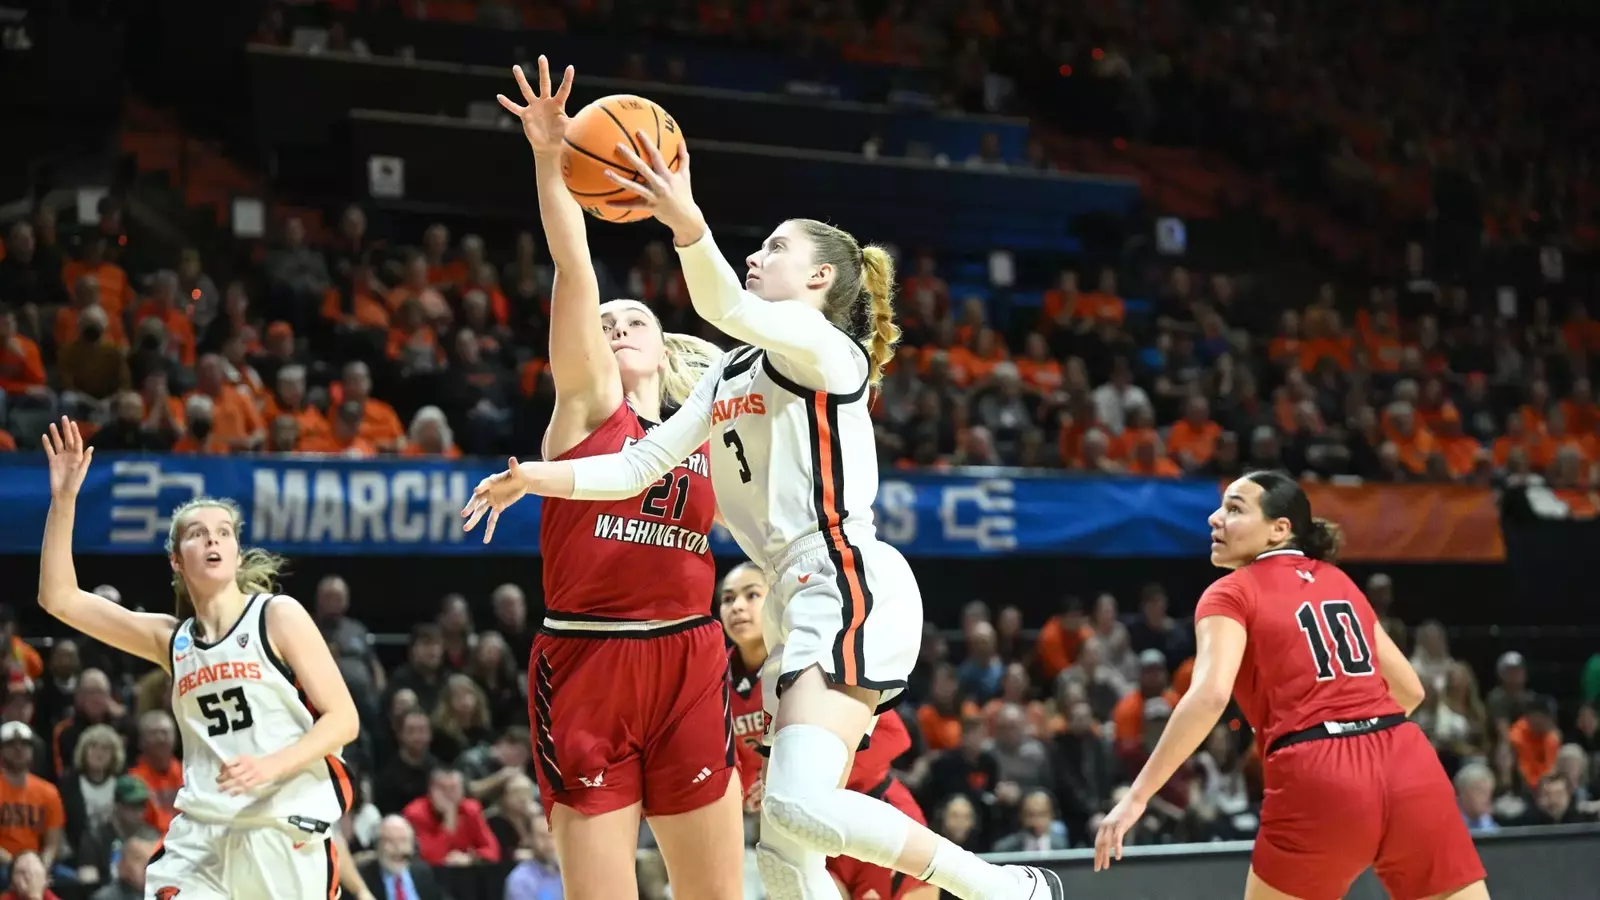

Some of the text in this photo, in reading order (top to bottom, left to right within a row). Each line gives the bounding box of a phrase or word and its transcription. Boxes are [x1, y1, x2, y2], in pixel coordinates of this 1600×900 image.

[711, 393, 767, 426] AVERS
[723, 429, 752, 484] 3
[251, 468, 467, 543] MARCH
[640, 472, 690, 521] 21
[593, 513, 710, 555] WASHINGTON
[1295, 600, 1375, 682] 10
[178, 661, 262, 697] BEAVERS
[196, 685, 255, 738] 53
